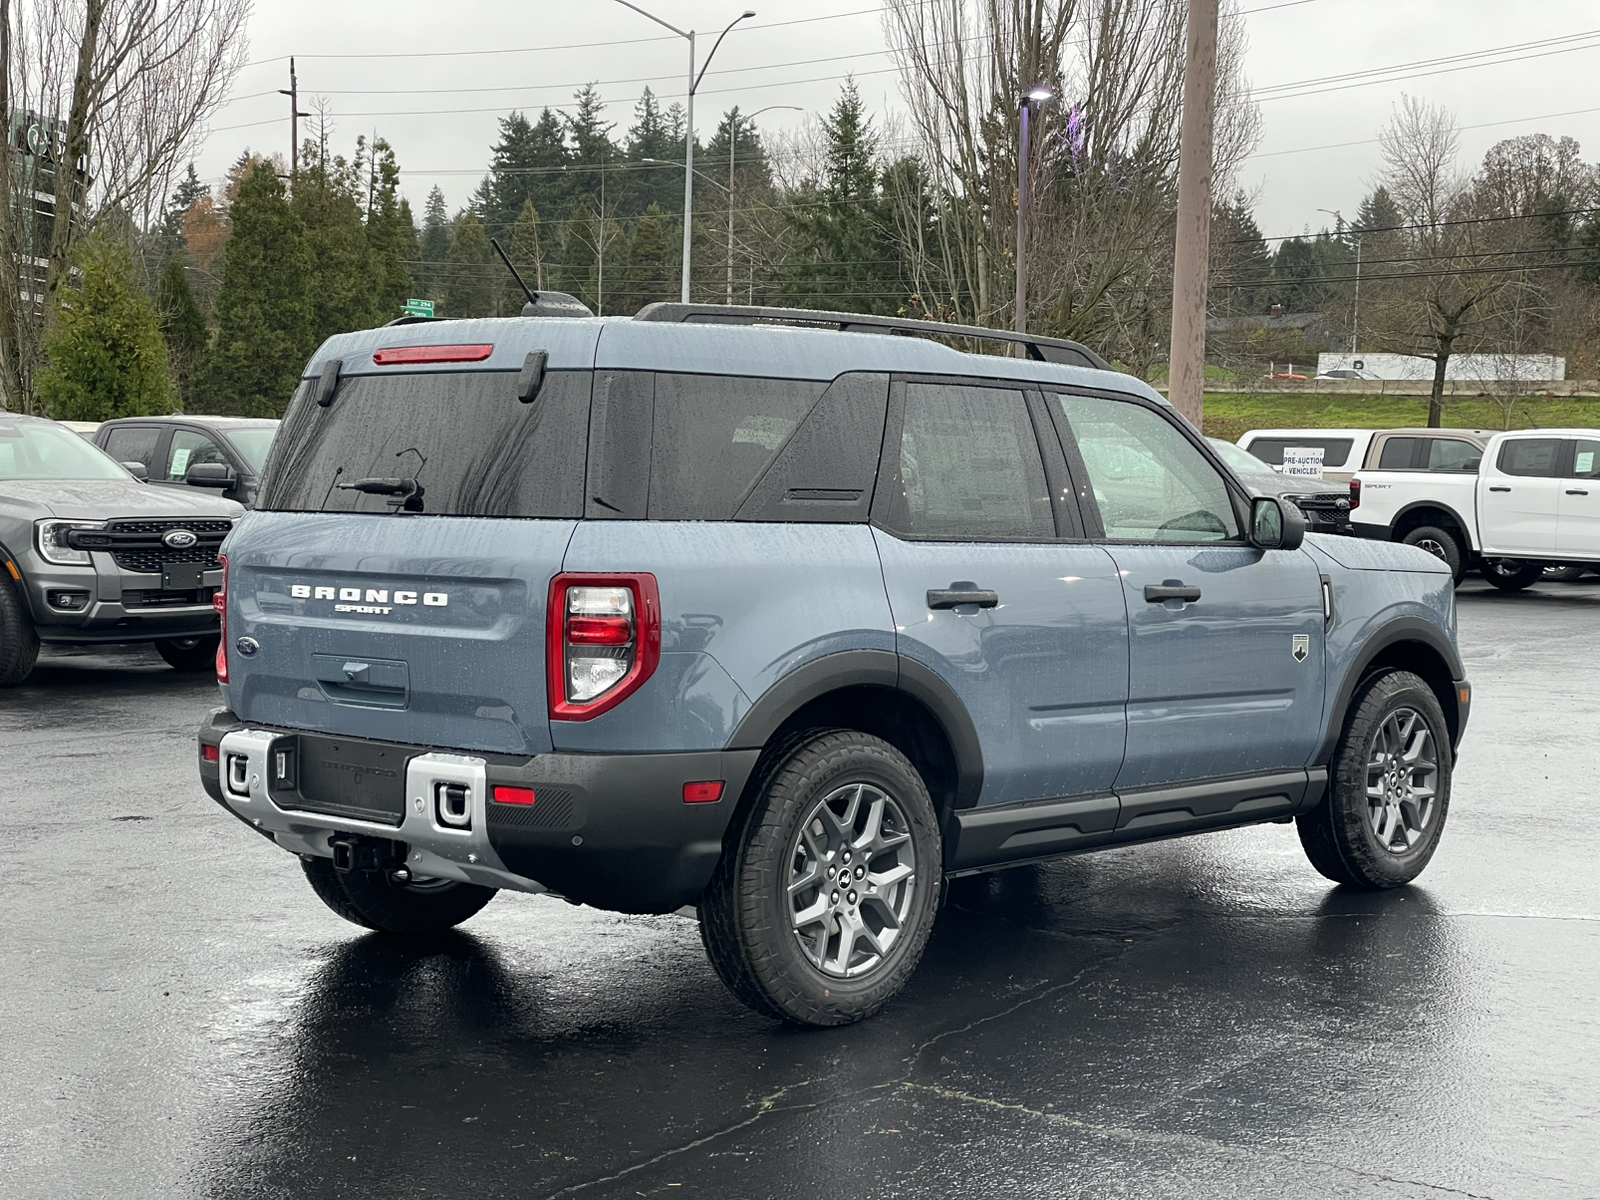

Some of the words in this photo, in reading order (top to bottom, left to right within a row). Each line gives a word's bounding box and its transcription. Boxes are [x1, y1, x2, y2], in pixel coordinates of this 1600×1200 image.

[1284, 456, 1324, 465] PRE-AUCTION
[1288, 467, 1318, 475] VEHICLES
[291, 584, 449, 607] BRONCO
[334, 604, 393, 615] SPORT
